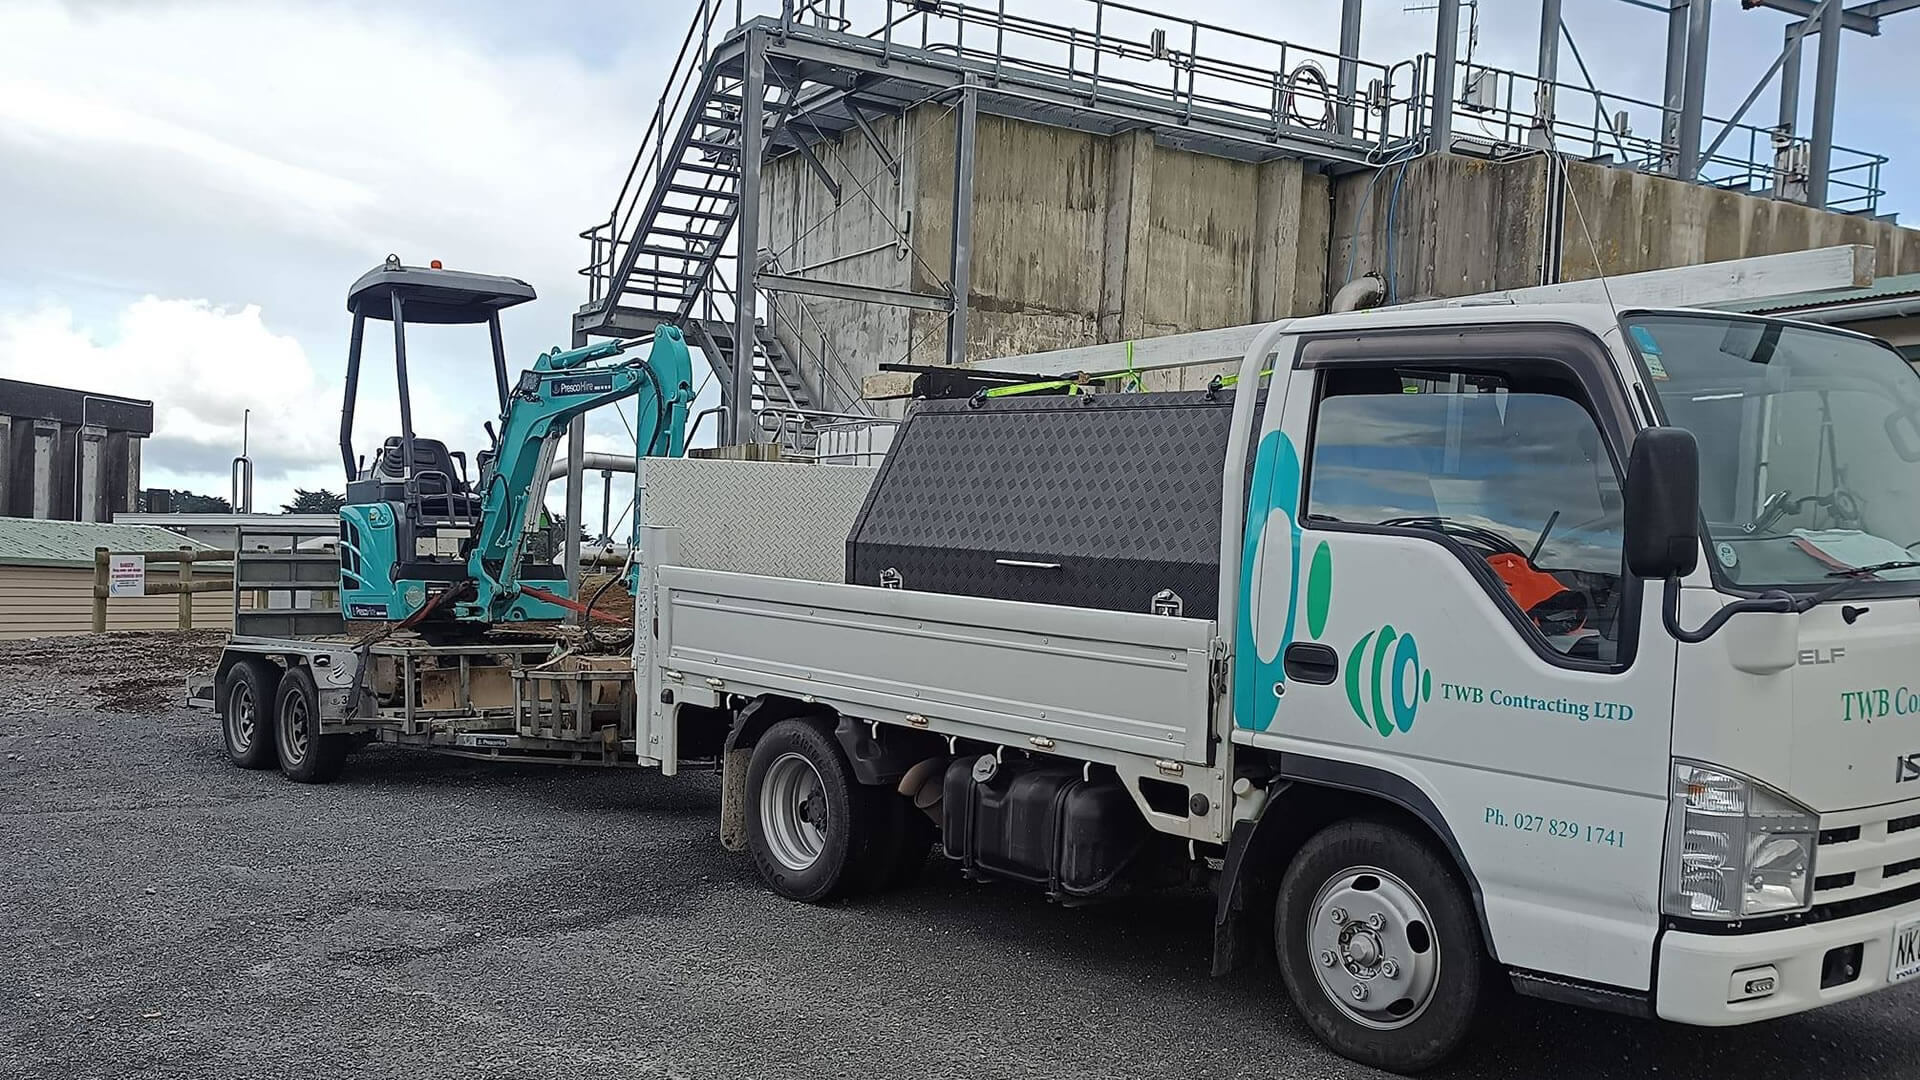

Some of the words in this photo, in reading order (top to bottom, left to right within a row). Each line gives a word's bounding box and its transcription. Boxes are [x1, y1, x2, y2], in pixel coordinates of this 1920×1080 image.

[1798, 647, 1845, 665] ELF
[1441, 683, 1484, 704] TWB
[1490, 689, 1589, 721] Contracting
[1593, 701, 1634, 721] LTD
[1841, 688, 1889, 721] TWB
[1895, 686, 1920, 715] Co
[1485, 807, 1509, 827] Ph.
[1514, 812, 1544, 833] 027
[1548, 818, 1579, 839] 829
[1586, 825, 1624, 848] 1741
[1895, 929, 1920, 968] NK
